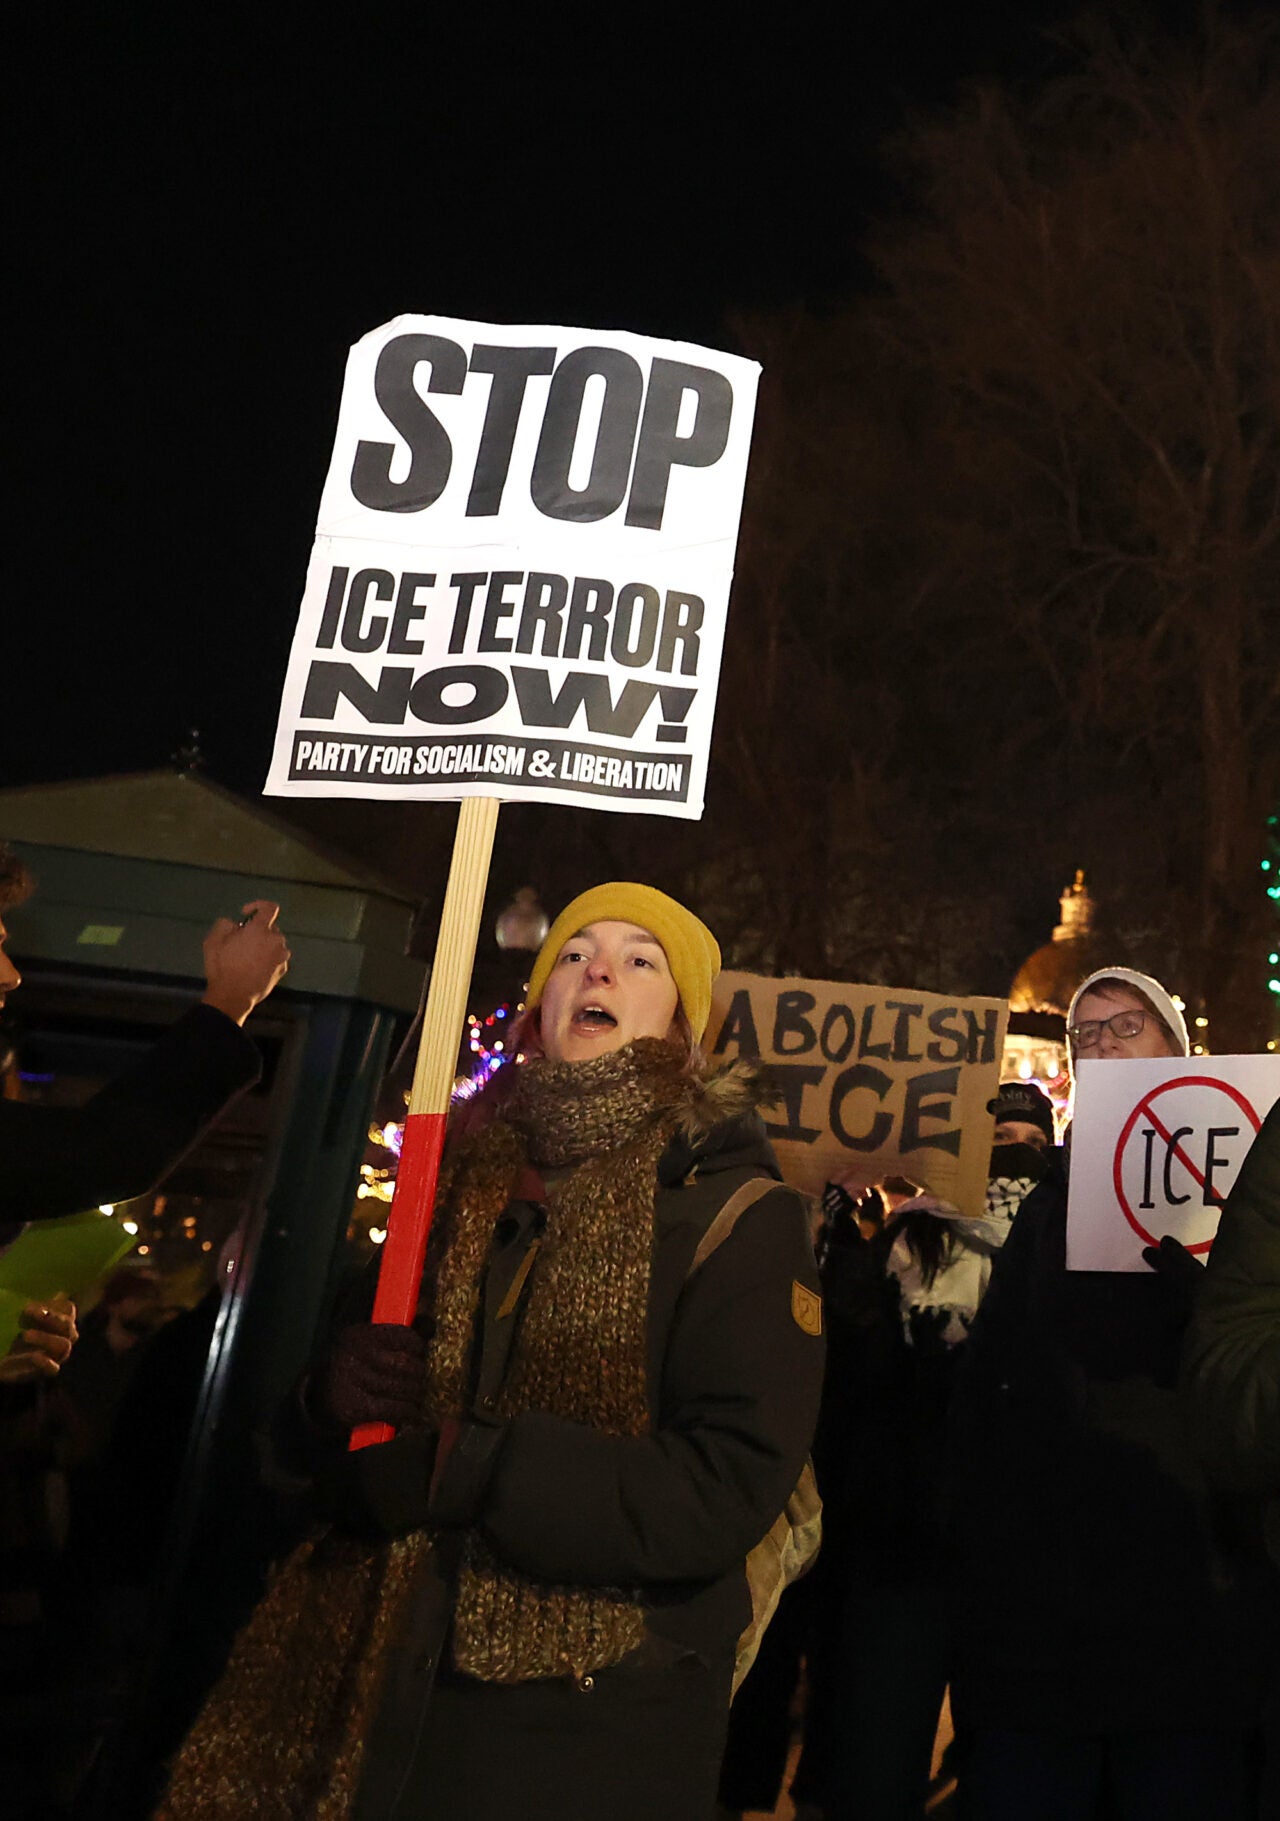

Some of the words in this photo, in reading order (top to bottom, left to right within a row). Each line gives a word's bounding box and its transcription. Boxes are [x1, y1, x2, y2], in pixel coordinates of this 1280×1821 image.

[349, 332, 735, 532] STOP
[315, 565, 437, 656] ICE
[447, 569, 706, 677] TERROR
[299, 660, 699, 744] NOW!
[296, 741, 369, 773] PARTY
[367, 743, 416, 777] FOR
[416, 745, 526, 777] SOCIALISM
[527, 749, 557, 779] &
[560, 752, 683, 793] LIBERATION
[713, 989, 1000, 1066] ABOLISH
[757, 1062, 962, 1158] ICE
[1138, 1126, 1241, 1210] ICE
